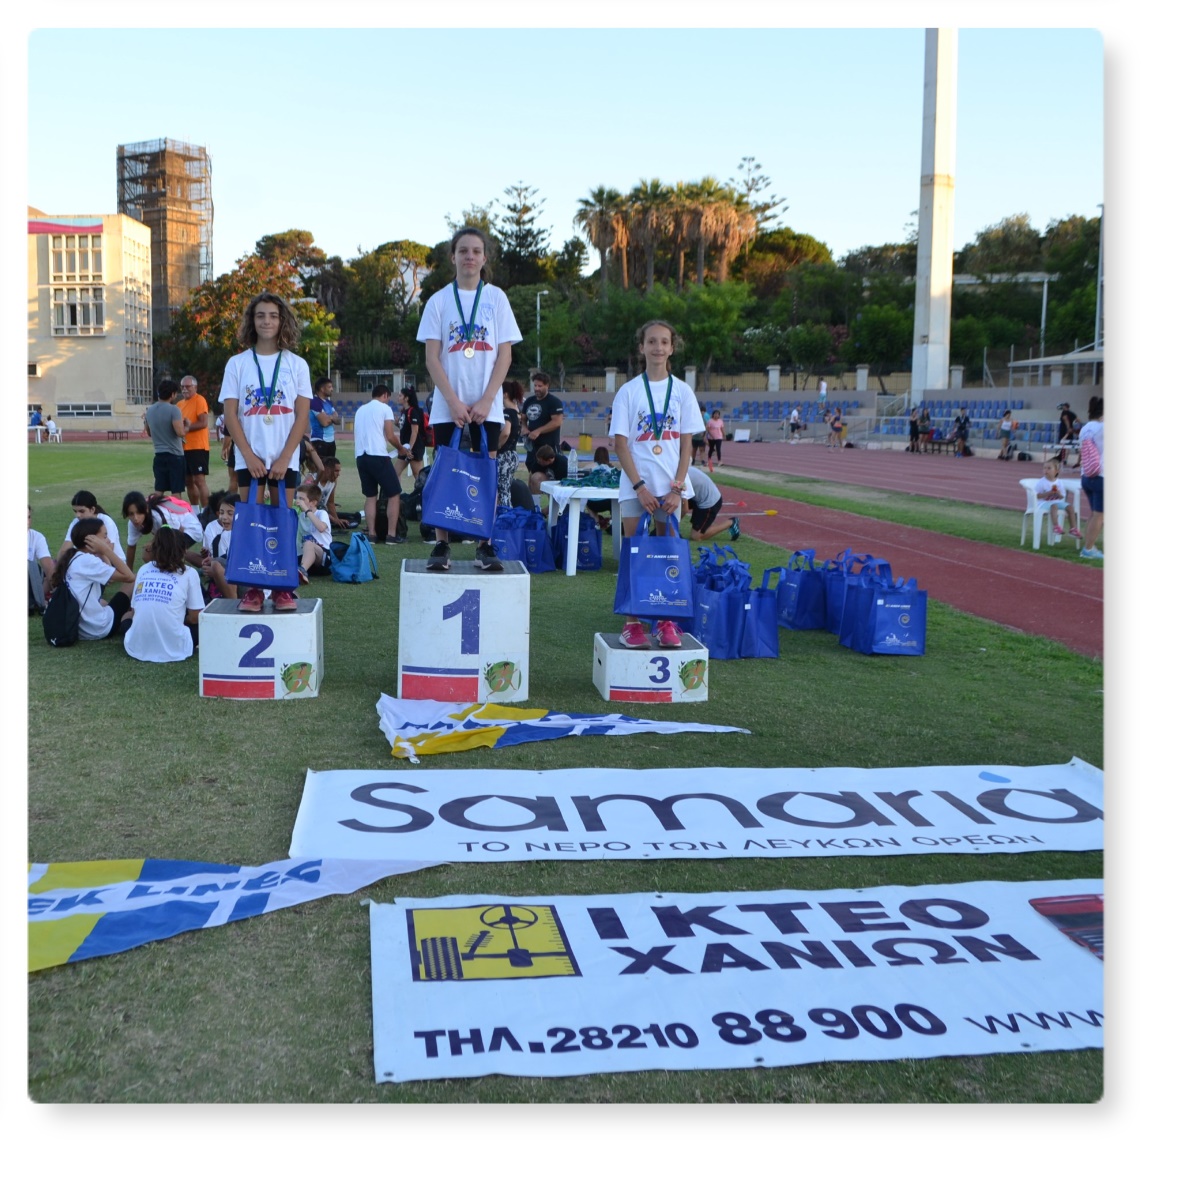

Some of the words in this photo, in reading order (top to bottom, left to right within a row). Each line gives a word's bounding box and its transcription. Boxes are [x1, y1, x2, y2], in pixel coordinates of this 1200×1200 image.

[144, 581, 173, 590] ΙΚΤΕΟ
[144, 588, 172, 596] ΧΑΝΙΩΝ
[442, 589, 481, 655] 1
[238, 624, 275, 668] 2
[648, 657, 671, 684] 3
[457, 841, 510, 853] ΤΟ
[525, 841, 632, 853] ΝΕΡΟ
[642, 840, 728, 852] ΤΩΝ
[743, 836, 902, 851] ΛΕΥΚΩΝ
[911, 834, 1045, 847] ΟΡΕΩΝ
[607, 933, 1042, 976] ΧΑΝΙΩΝ
